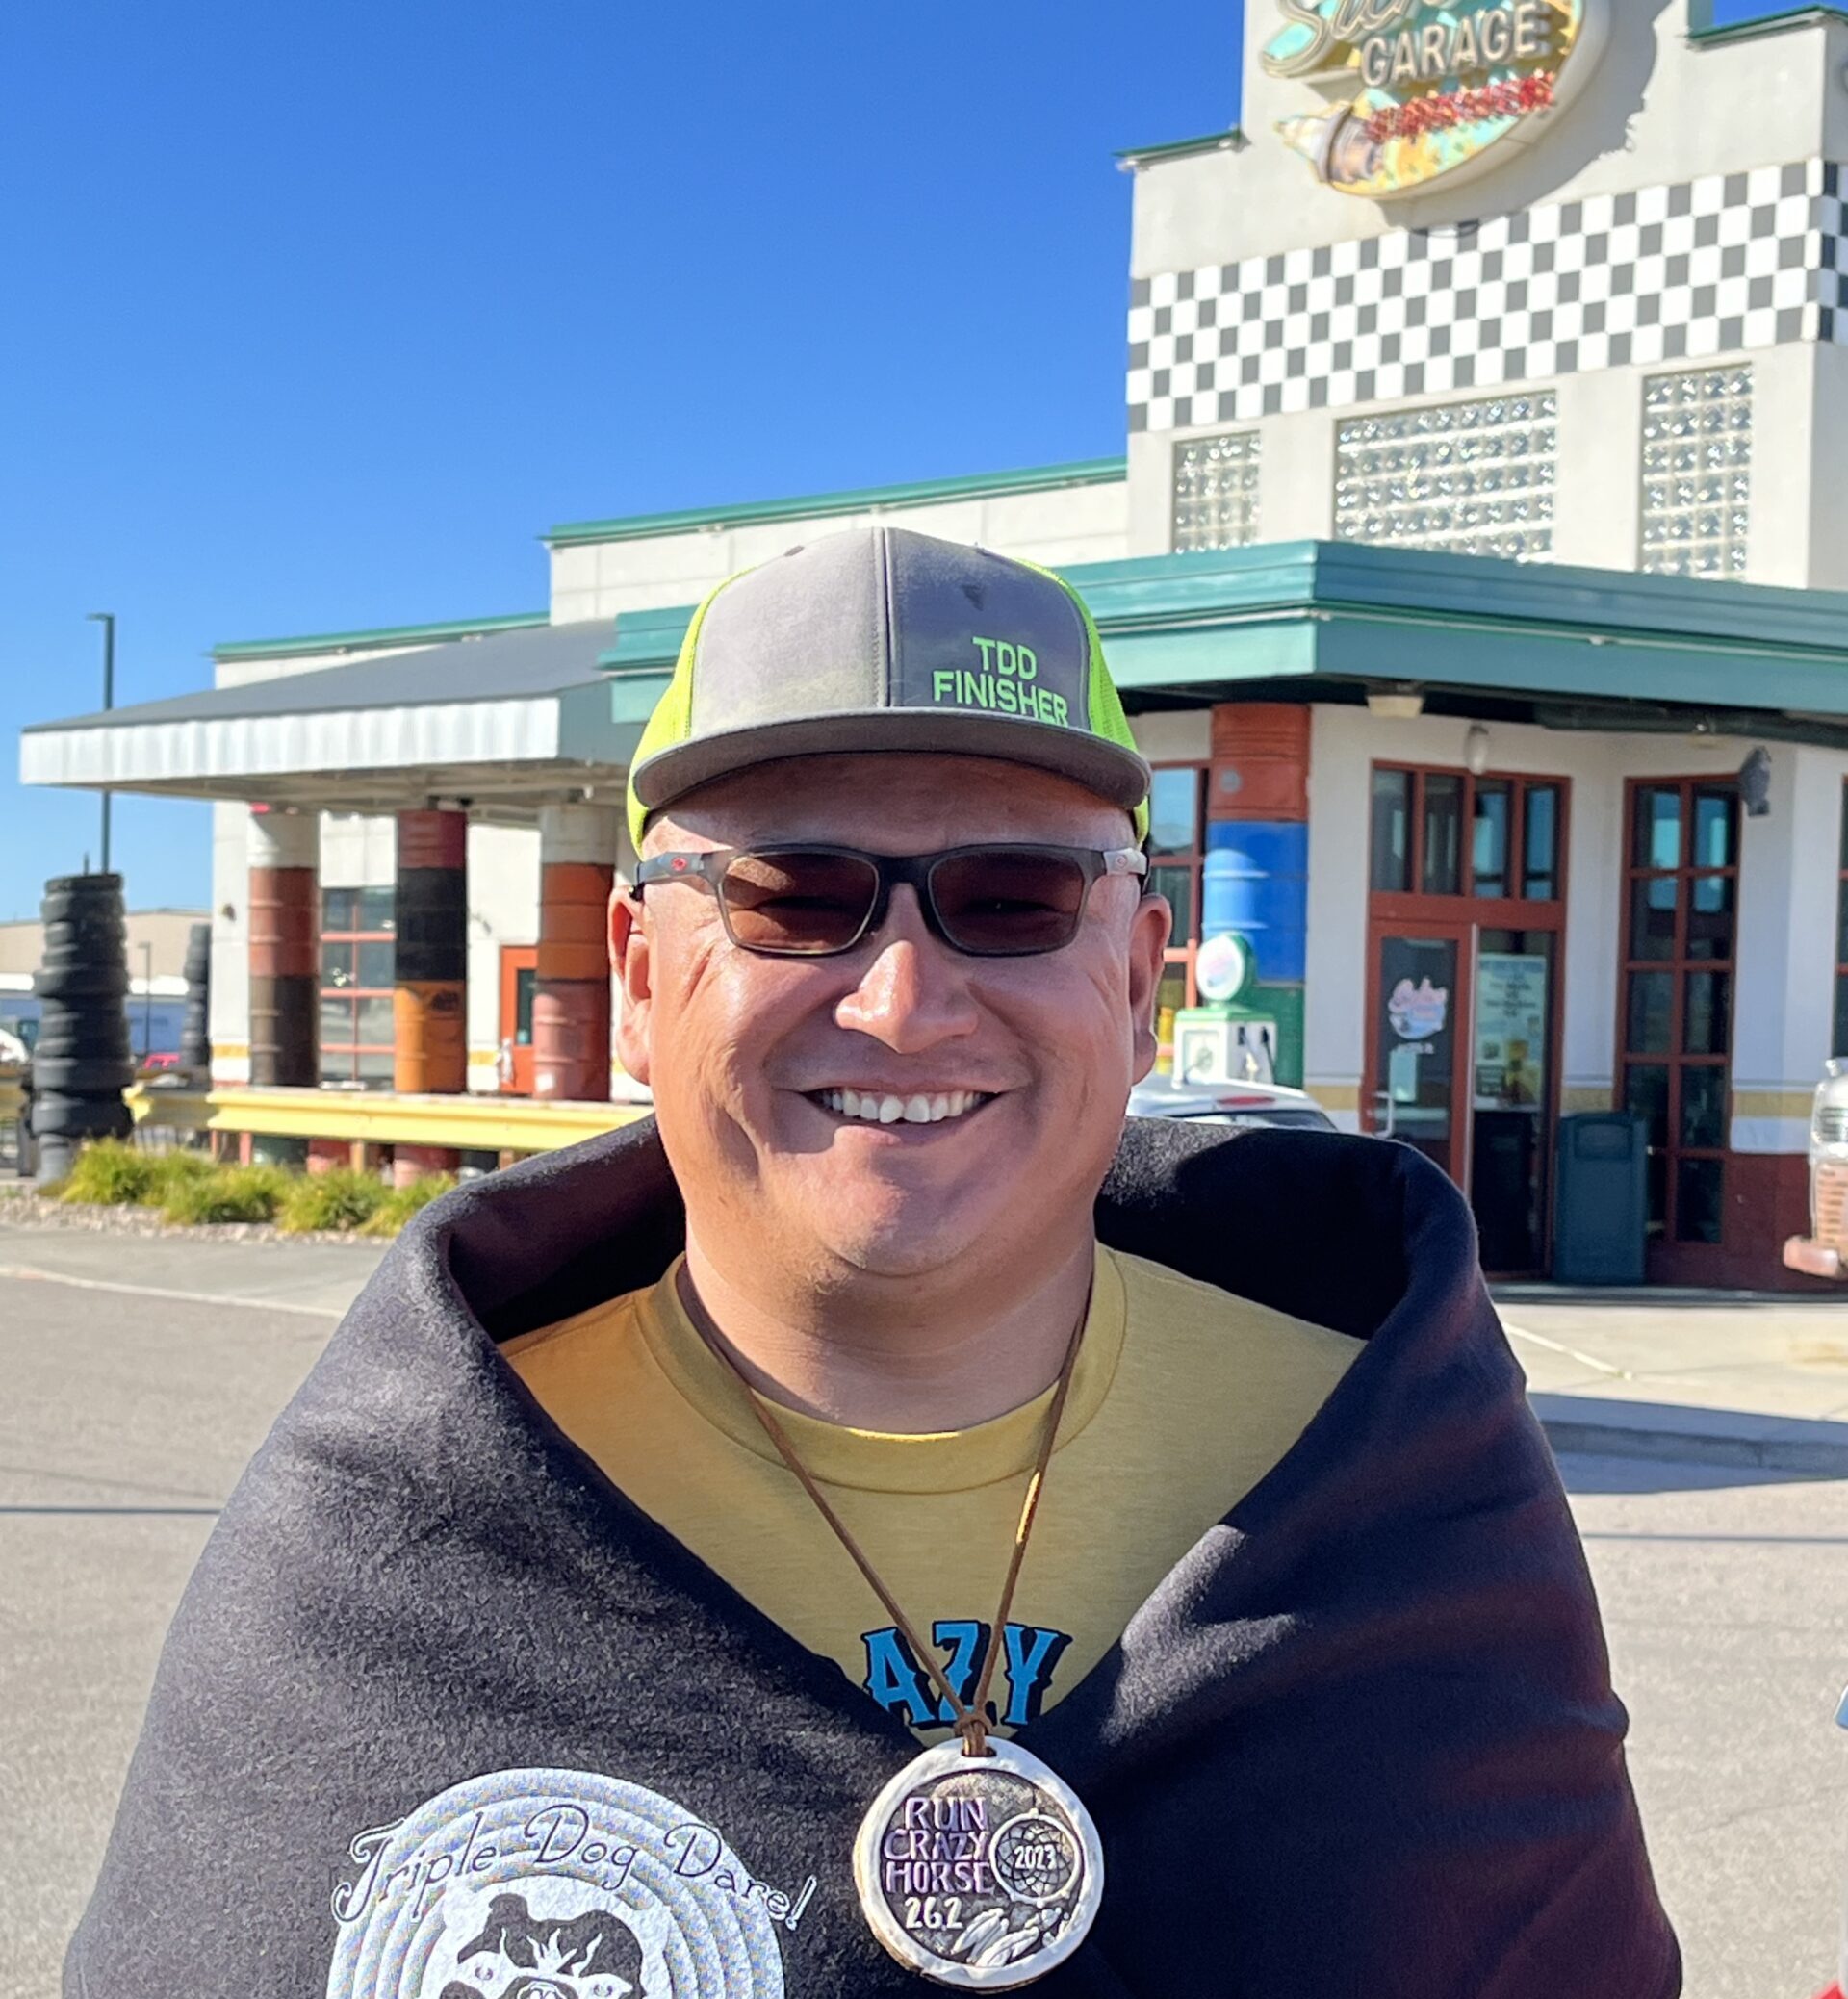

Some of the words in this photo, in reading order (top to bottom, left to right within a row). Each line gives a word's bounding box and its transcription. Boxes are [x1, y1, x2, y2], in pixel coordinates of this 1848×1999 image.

[1360, 2, 1541, 88] GARAGE
[972, 636, 1037, 680] TDD
[933, 670, 1068, 728] FINISHER
[904, 1796, 988, 1830] RUN
[884, 1828, 989, 1861] CRAZY
[1014, 1843, 1057, 1870] 2023
[331, 1810, 497, 1923] Triple
[524, 1804, 637, 1890] Dog
[663, 1822, 818, 1930] Dare!
[886, 1861, 994, 1894] HORSE
[905, 1896, 963, 1931] 26.2
